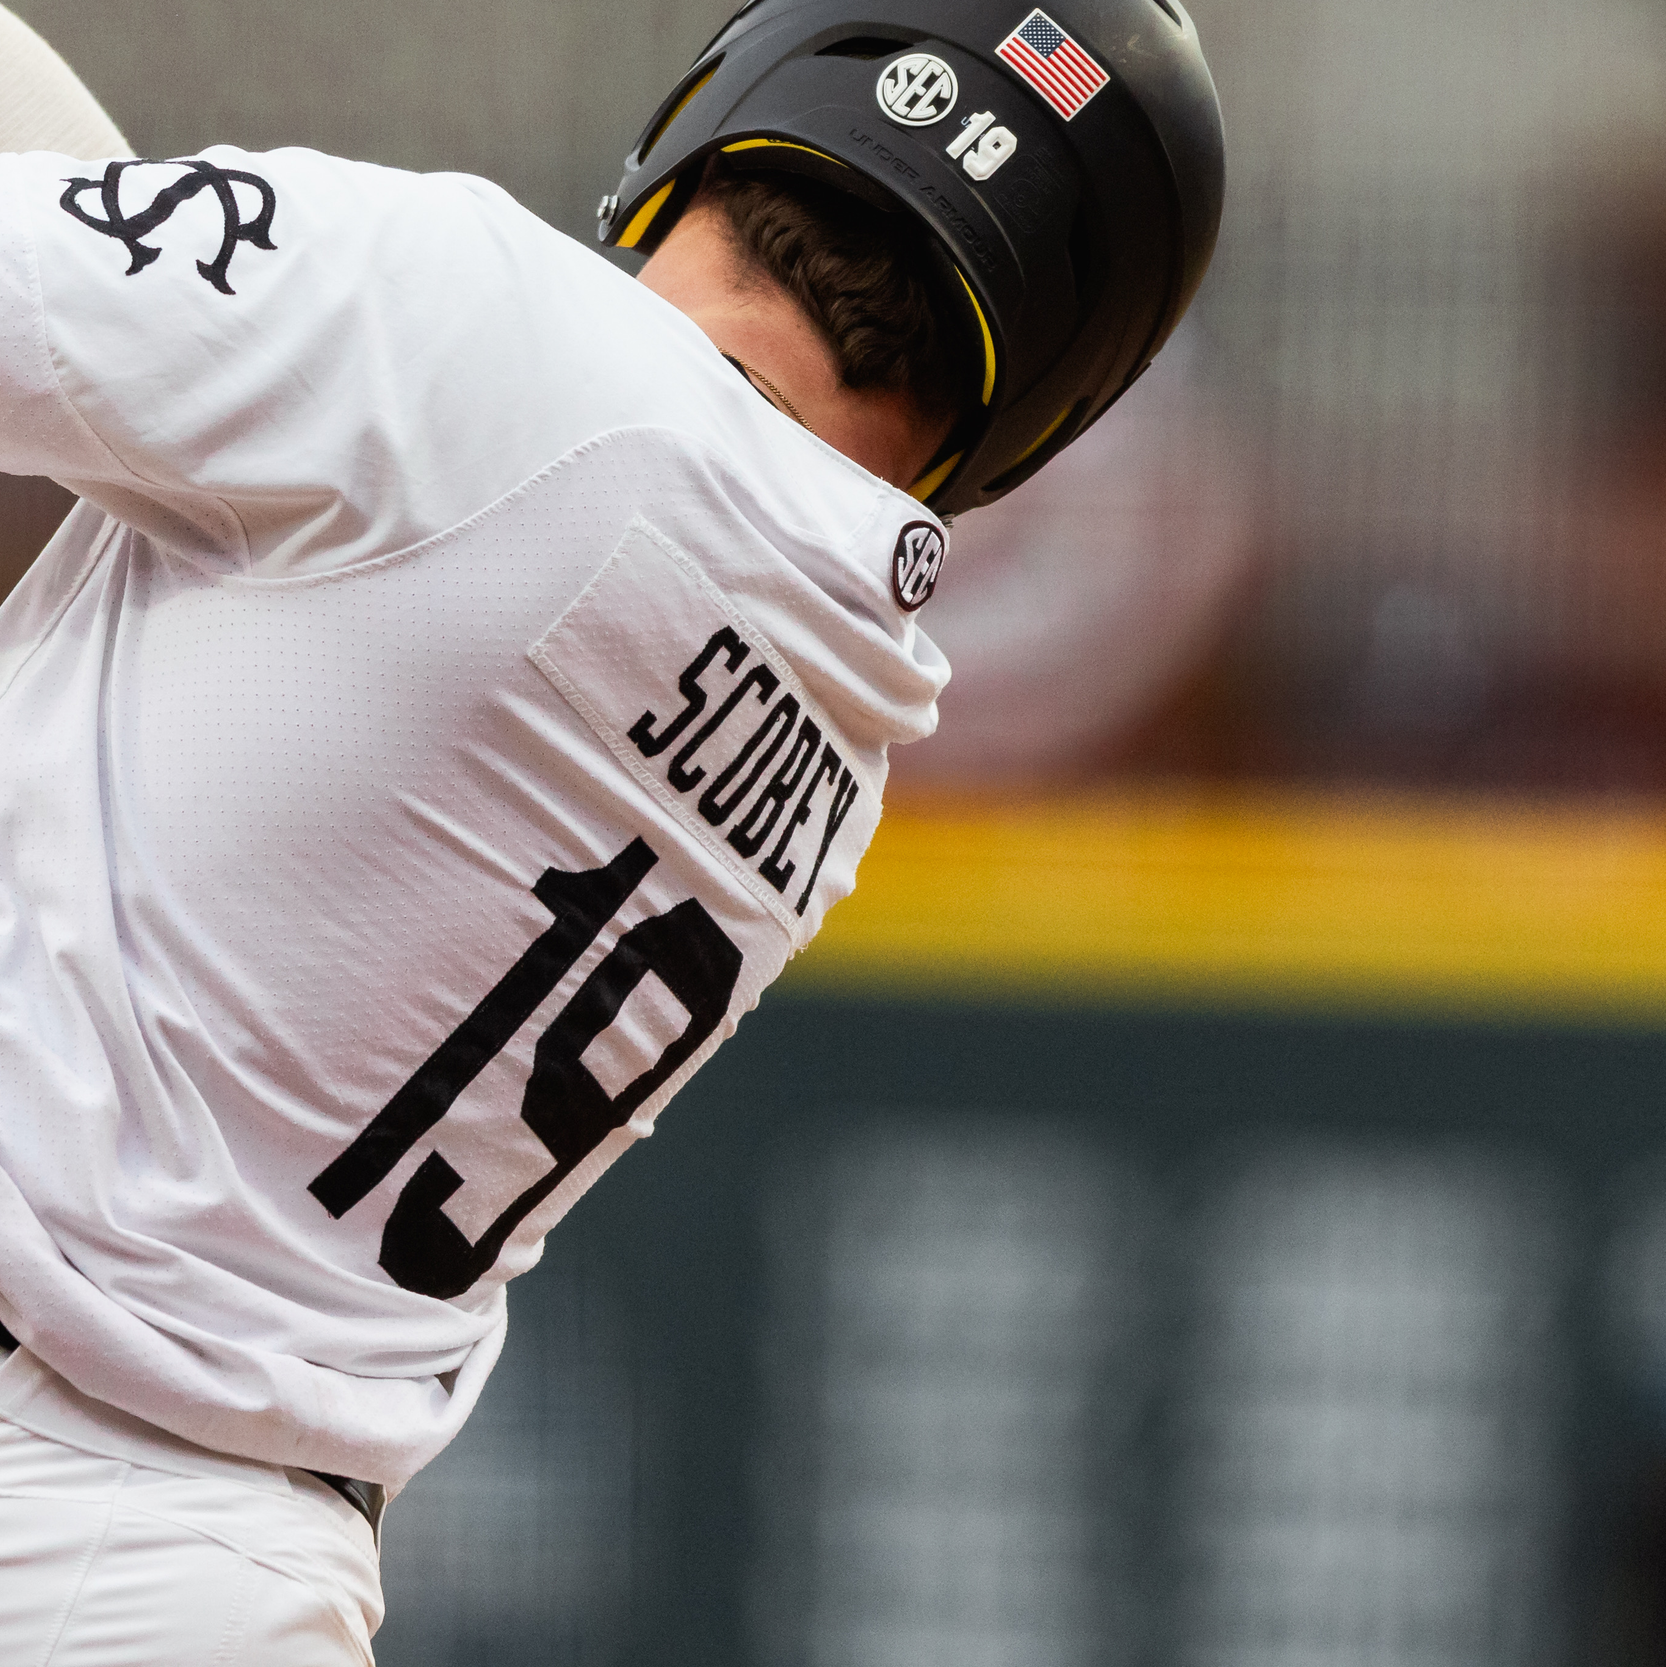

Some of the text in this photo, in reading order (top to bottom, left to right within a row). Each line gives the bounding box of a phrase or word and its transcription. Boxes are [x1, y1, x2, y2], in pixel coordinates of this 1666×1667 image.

[882, 56, 952, 121] SEC
[849, 128, 921, 183] UNDER
[919, 185, 998, 273] ARMOUR
[945, 110, 1018, 182] 19
[897, 526, 943, 606] SEC
[627, 625, 859, 918] SCOBEY
[306, 835, 745, 1301] 19
